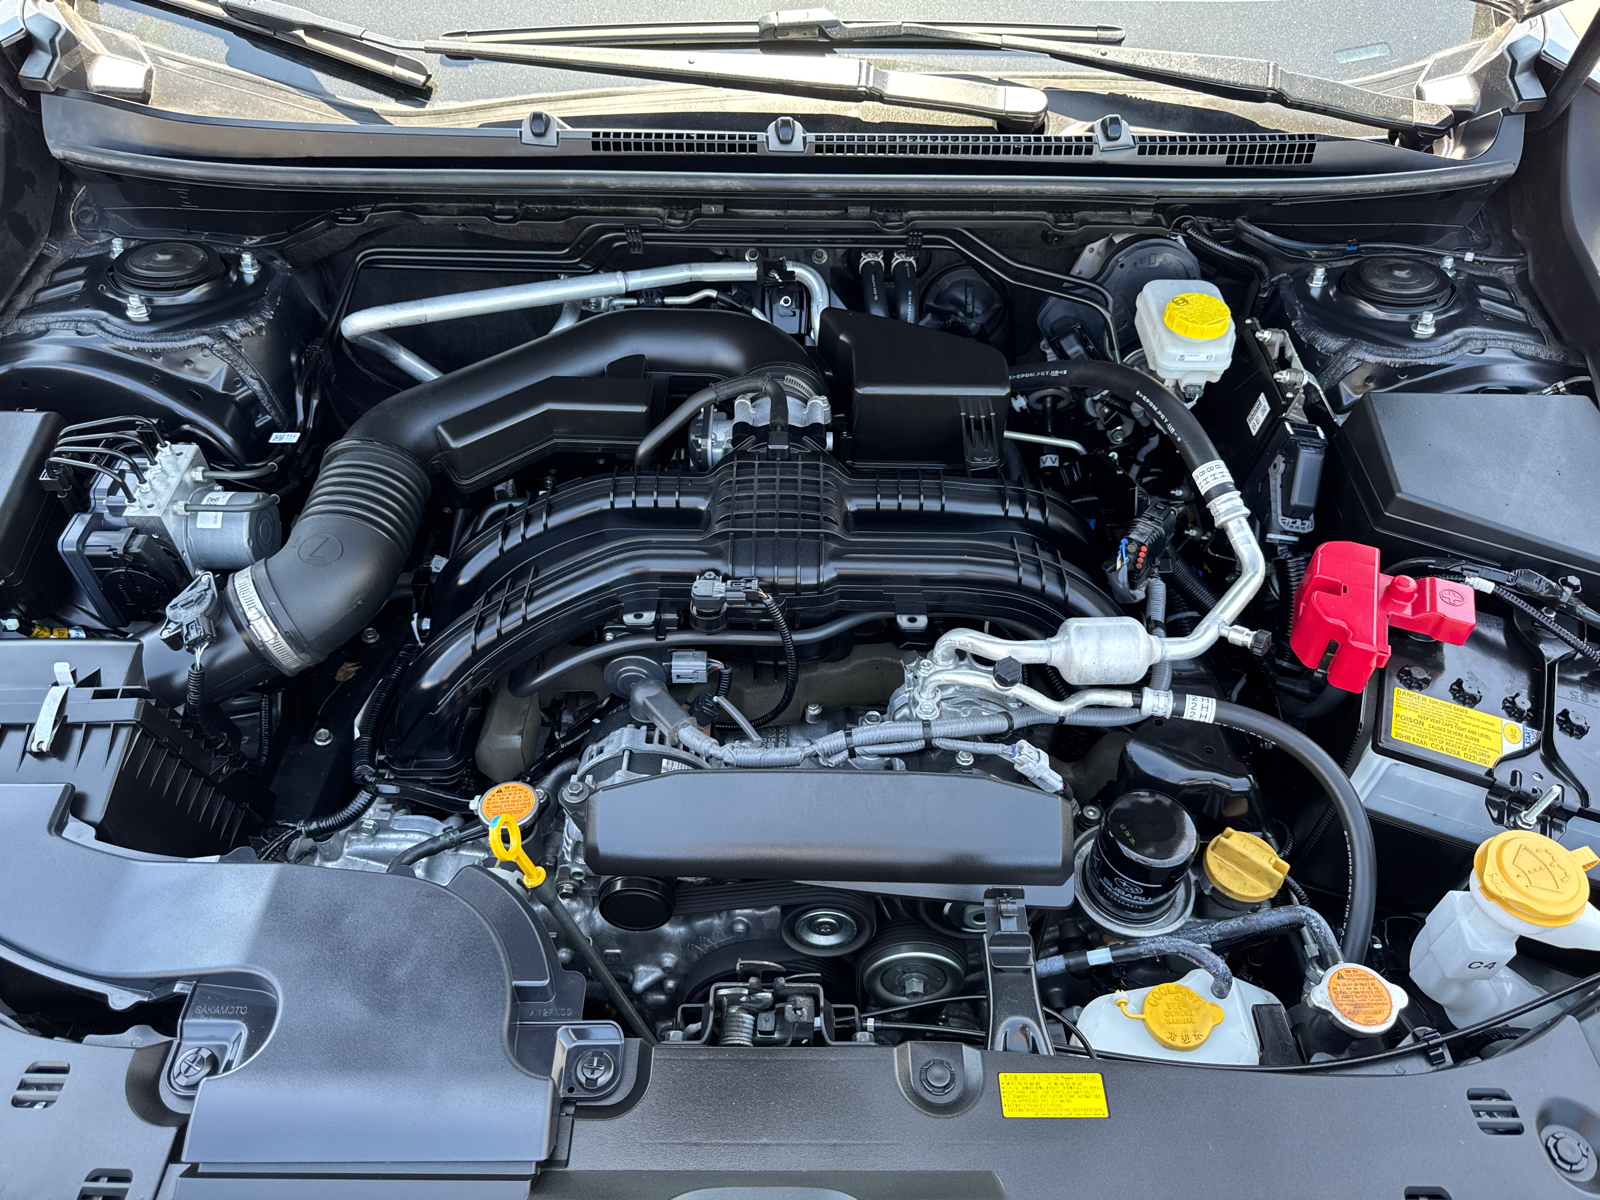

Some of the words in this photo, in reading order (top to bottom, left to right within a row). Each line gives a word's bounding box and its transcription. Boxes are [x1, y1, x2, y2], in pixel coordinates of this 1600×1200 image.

[1396, 689, 1426, 702] DANGER
[1428, 698, 1451, 709] EXPLOSIVE
[1452, 706, 1467, 714] GASES
[1395, 712, 1424, 726] POISON
[1428, 723, 1445, 732] CAUSES
[1446, 729, 1463, 738] SEVERE
[1464, 734, 1479, 742] BURNS
[1478, 732, 1491, 740] LEVEL
[1394, 731, 1410, 741] 20HR
[1412, 736, 1427, 746] 62Ah
[1430, 742, 1444, 751] CCA
[1445, 747, 1460, 756] 620A
[1463, 752, 1489, 765] D23(JIS)
[1445, 741, 1460, 750] REACH
[1468, 748, 1490, 759] CHILDREN
[1103, 876, 1152, 902] SUBARU
[1467, 961, 1497, 970] C4
[1148, 985, 1203, 1007] COOLANT
[195, 1006, 248, 1014] SAKAMOTO
